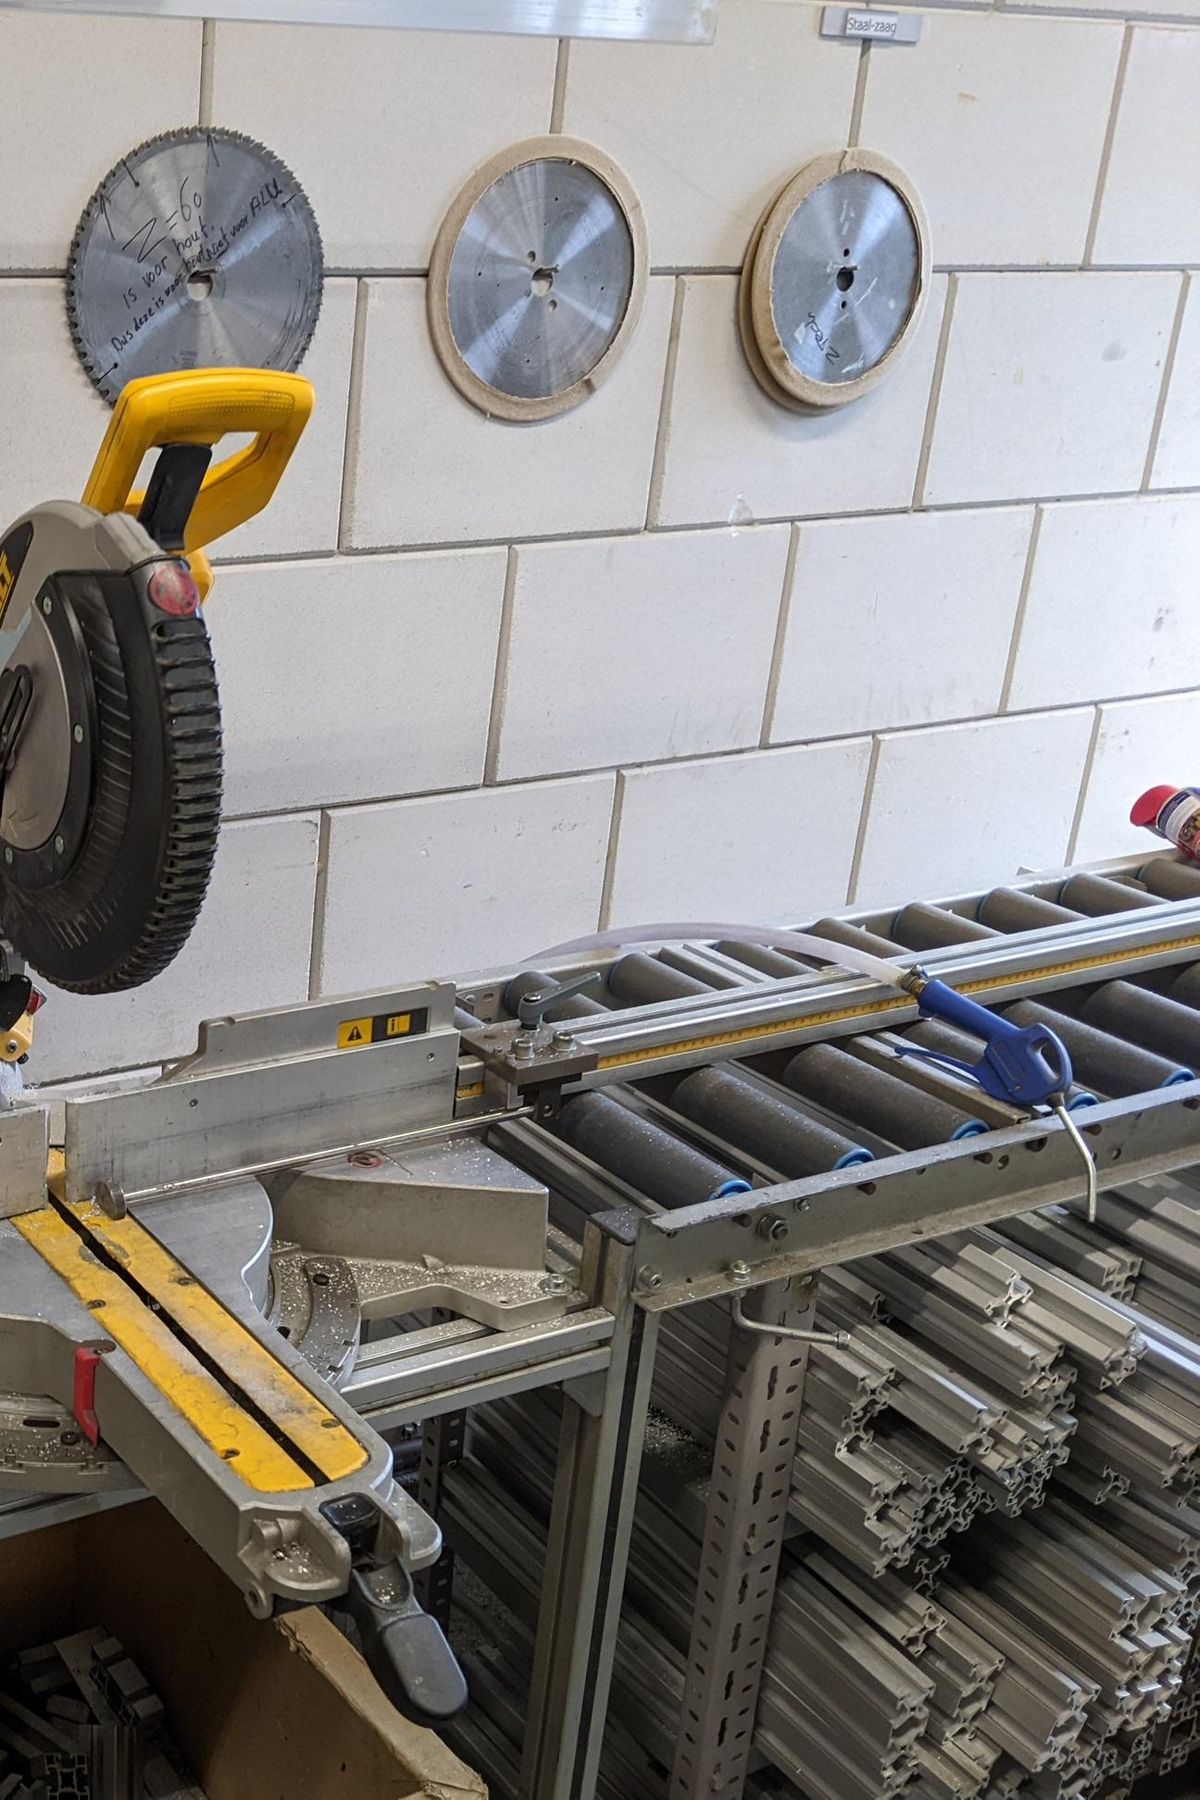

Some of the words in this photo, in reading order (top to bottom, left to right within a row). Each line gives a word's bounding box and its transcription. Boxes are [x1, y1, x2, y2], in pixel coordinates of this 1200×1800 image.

[847, 17, 897, 37] Staal-zaag
[111, 330, 134, 352] Dus
[249, 177, 284, 218] ALU
